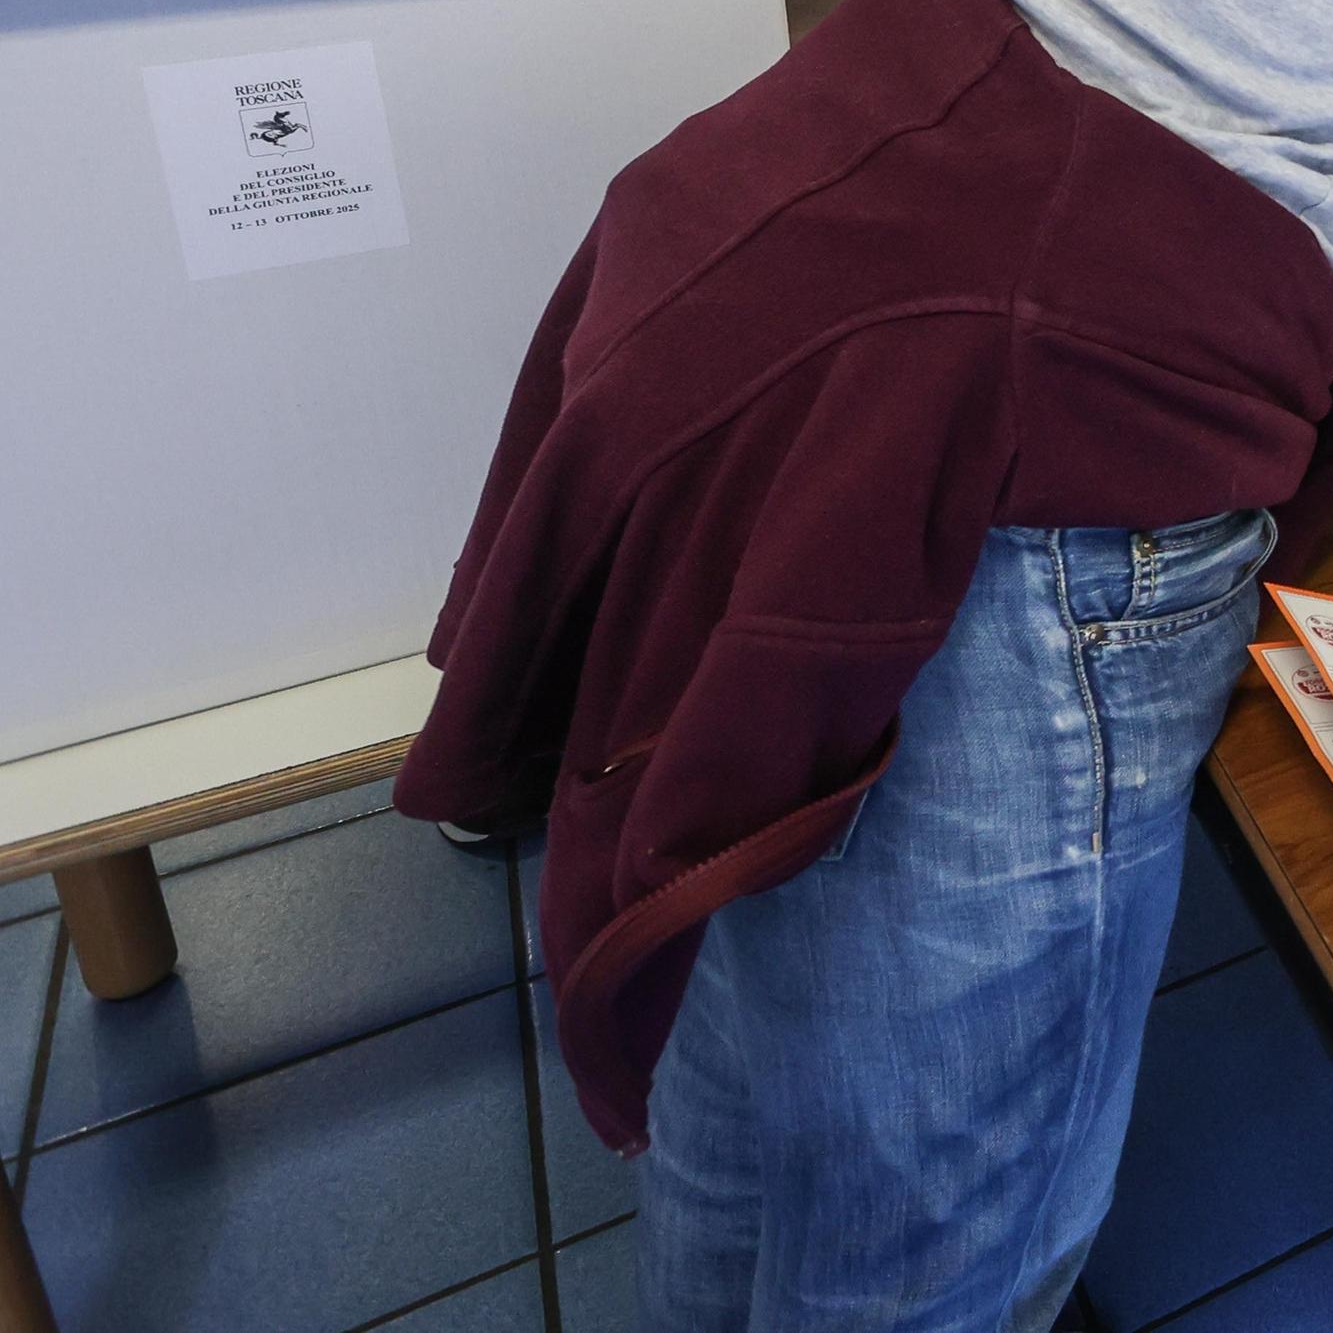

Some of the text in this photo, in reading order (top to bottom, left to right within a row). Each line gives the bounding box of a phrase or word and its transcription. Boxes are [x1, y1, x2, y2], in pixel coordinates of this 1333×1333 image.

[234, 78, 303, 96] REGIONE
[236, 90, 304, 107] TOSCANA
[240, 170, 335, 191] DEL CONSIGLIO
[256, 163, 315, 179] ELEZIONI
[208, 184, 374, 216] DELLA GIUNTA REGIONALE
[233, 178, 346, 202] E DEL PRESIDENTE
[231, 222, 243, 231] 12
[255, 218, 267, 228] 13
[275, 207, 334, 224] OTTOBRE
[336, 203, 360, 215] 2025
